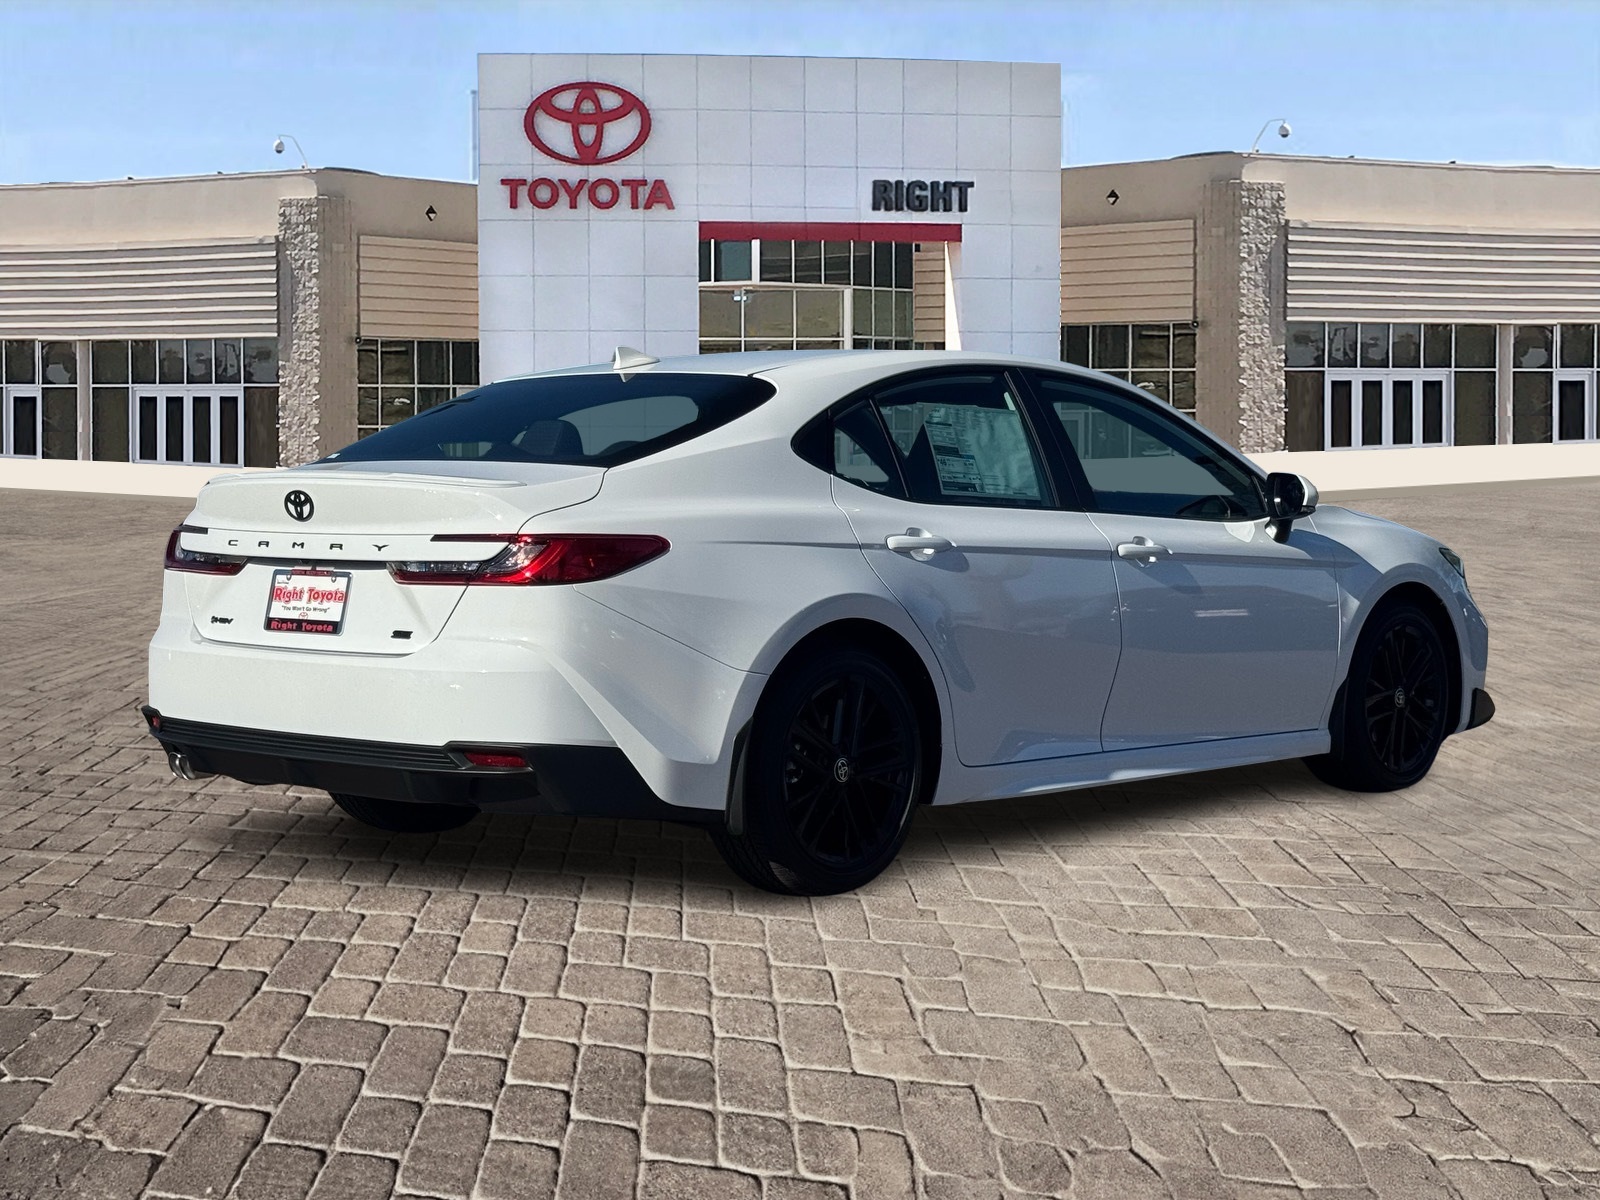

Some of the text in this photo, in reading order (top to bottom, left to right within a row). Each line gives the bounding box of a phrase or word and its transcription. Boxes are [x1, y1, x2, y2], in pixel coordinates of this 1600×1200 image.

[500, 178, 675, 210] TOYOTA
[871, 179, 975, 212] RIGHT
[228, 539, 389, 552] CAMRY
[274, 586, 344, 603] Right Toyota
[270, 621, 333, 632] Right Toyota
